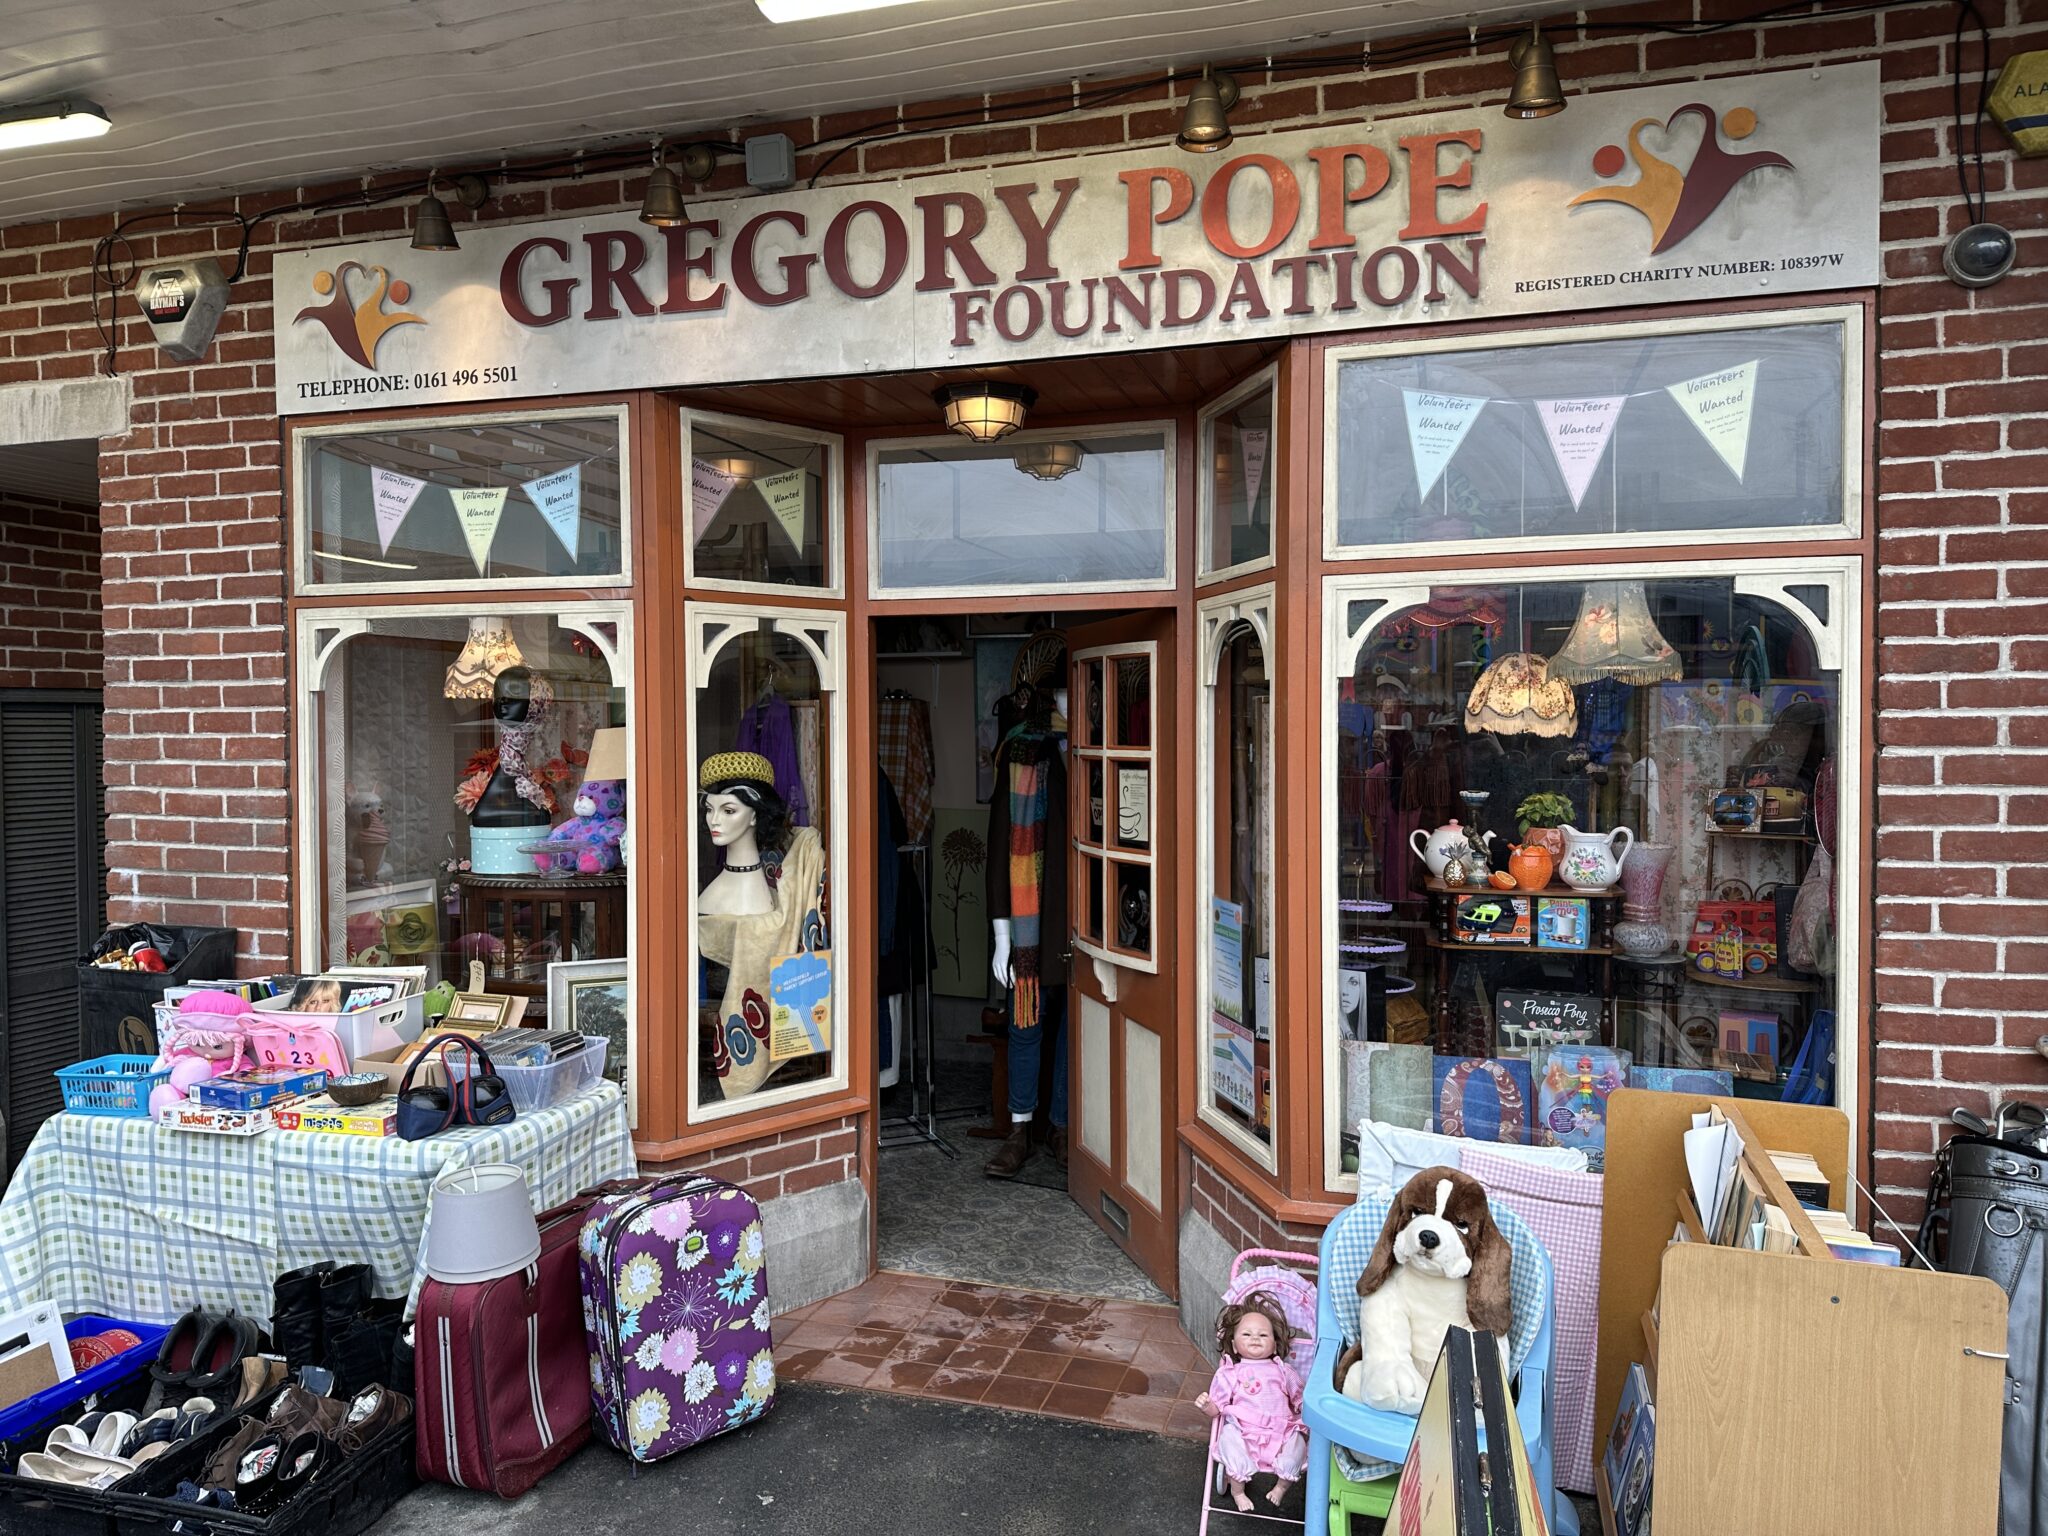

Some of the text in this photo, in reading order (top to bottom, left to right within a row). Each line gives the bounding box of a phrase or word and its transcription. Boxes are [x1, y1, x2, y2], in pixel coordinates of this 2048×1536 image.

[499, 128, 1489, 328] GREGORY POPE
[1514, 253, 1845, 294] REGISTERED CHARITY NUMBER: 108397W
[949, 237, 1487, 348] FOUNDATION
[297, 366, 518, 399] TELEPHONE: 0161 496 5501
[1686, 370, 1744, 394] Volunteers
[1418, 395, 1472, 410] Volunteers
[1554, 401, 1611, 414] Volunteers
[1699, 390, 1744, 414] Wanted
[1419, 417, 1462, 431] Wanted
[1559, 422, 1604, 436] Wanted
[380, 472, 415, 489] Volunteers
[536, 471, 573, 491] Volunteers
[692, 478, 721, 496] Wanted
[765, 473, 799, 488] Volunteers
[380, 489, 408, 504] Wanted
[462, 491, 499, 501] Volunteers
[545, 489, 574, 507] Wanted
[774, 489, 800, 504] Wanted
[466, 508, 496, 517] Wanted
[1522, 999, 1588, 1026] Prosecco Pong
[290, 1051, 302, 1064] 2
[304, 1051, 315, 1065] 3
[178, 1109, 215, 1126] Twister
